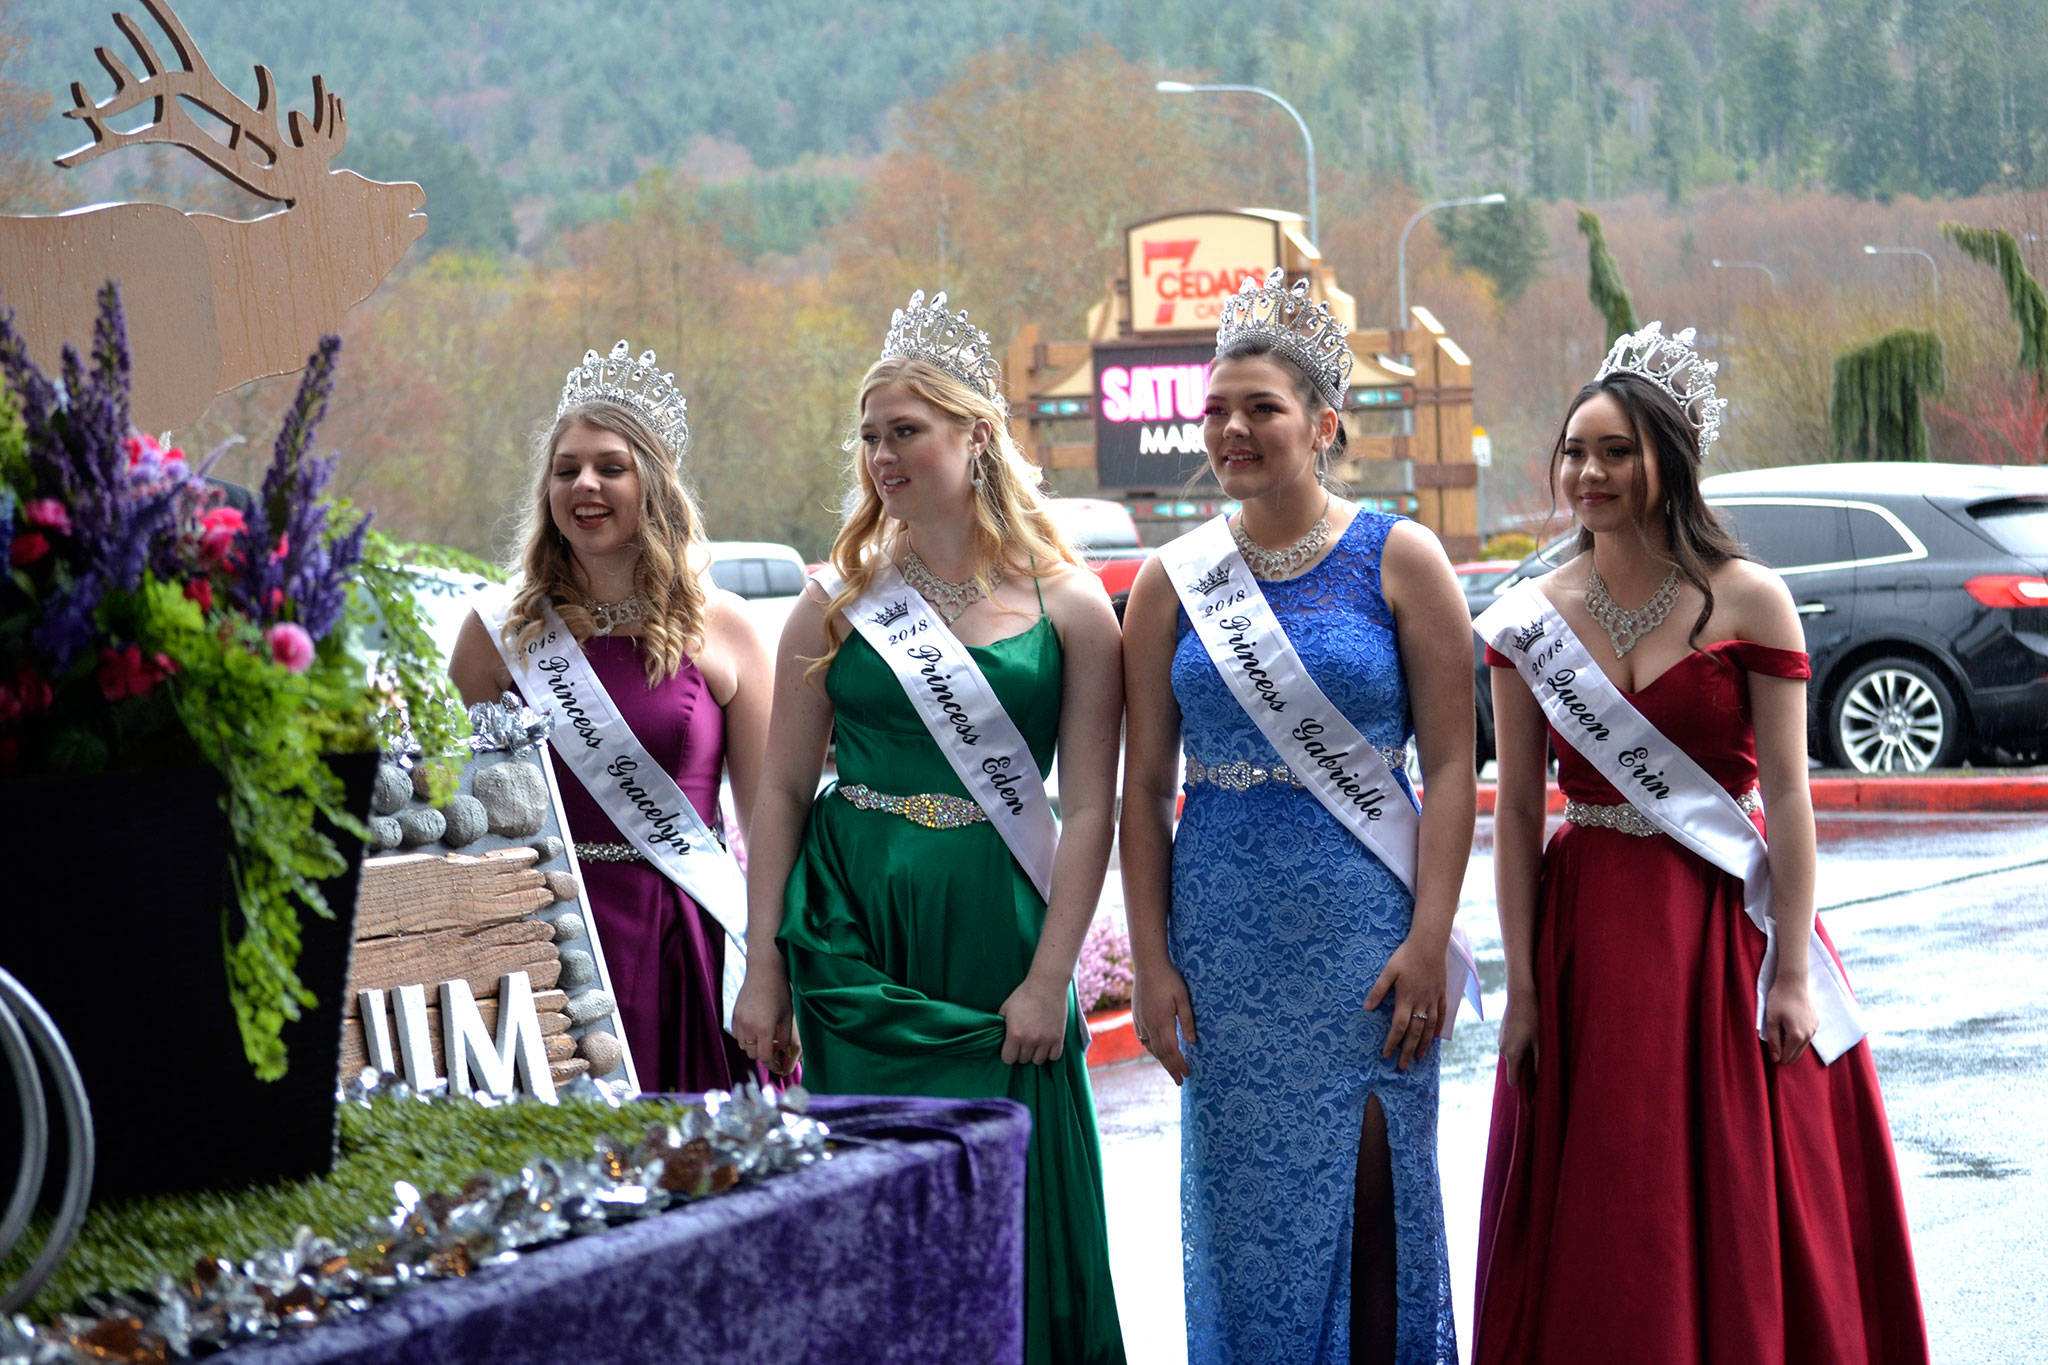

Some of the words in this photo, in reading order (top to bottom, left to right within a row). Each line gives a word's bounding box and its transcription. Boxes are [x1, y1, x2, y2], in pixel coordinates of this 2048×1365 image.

[1101, 364, 1212, 422] SATU
[888, 619, 929, 646] 2018
[1204, 589, 1245, 616] 2018
[1531, 639, 1564, 676] 2018
[538, 656, 601, 749] Princess
[607, 755, 691, 855] Gracelyn
[907, 645, 982, 746] Princess
[982, 756, 1025, 816] Eden
[1219, 615, 1285, 713] Princess
[1292, 718, 1385, 820] Gabrielle
[1547, 669, 1611, 742] Queen
[1618, 747, 1671, 800] Erin
